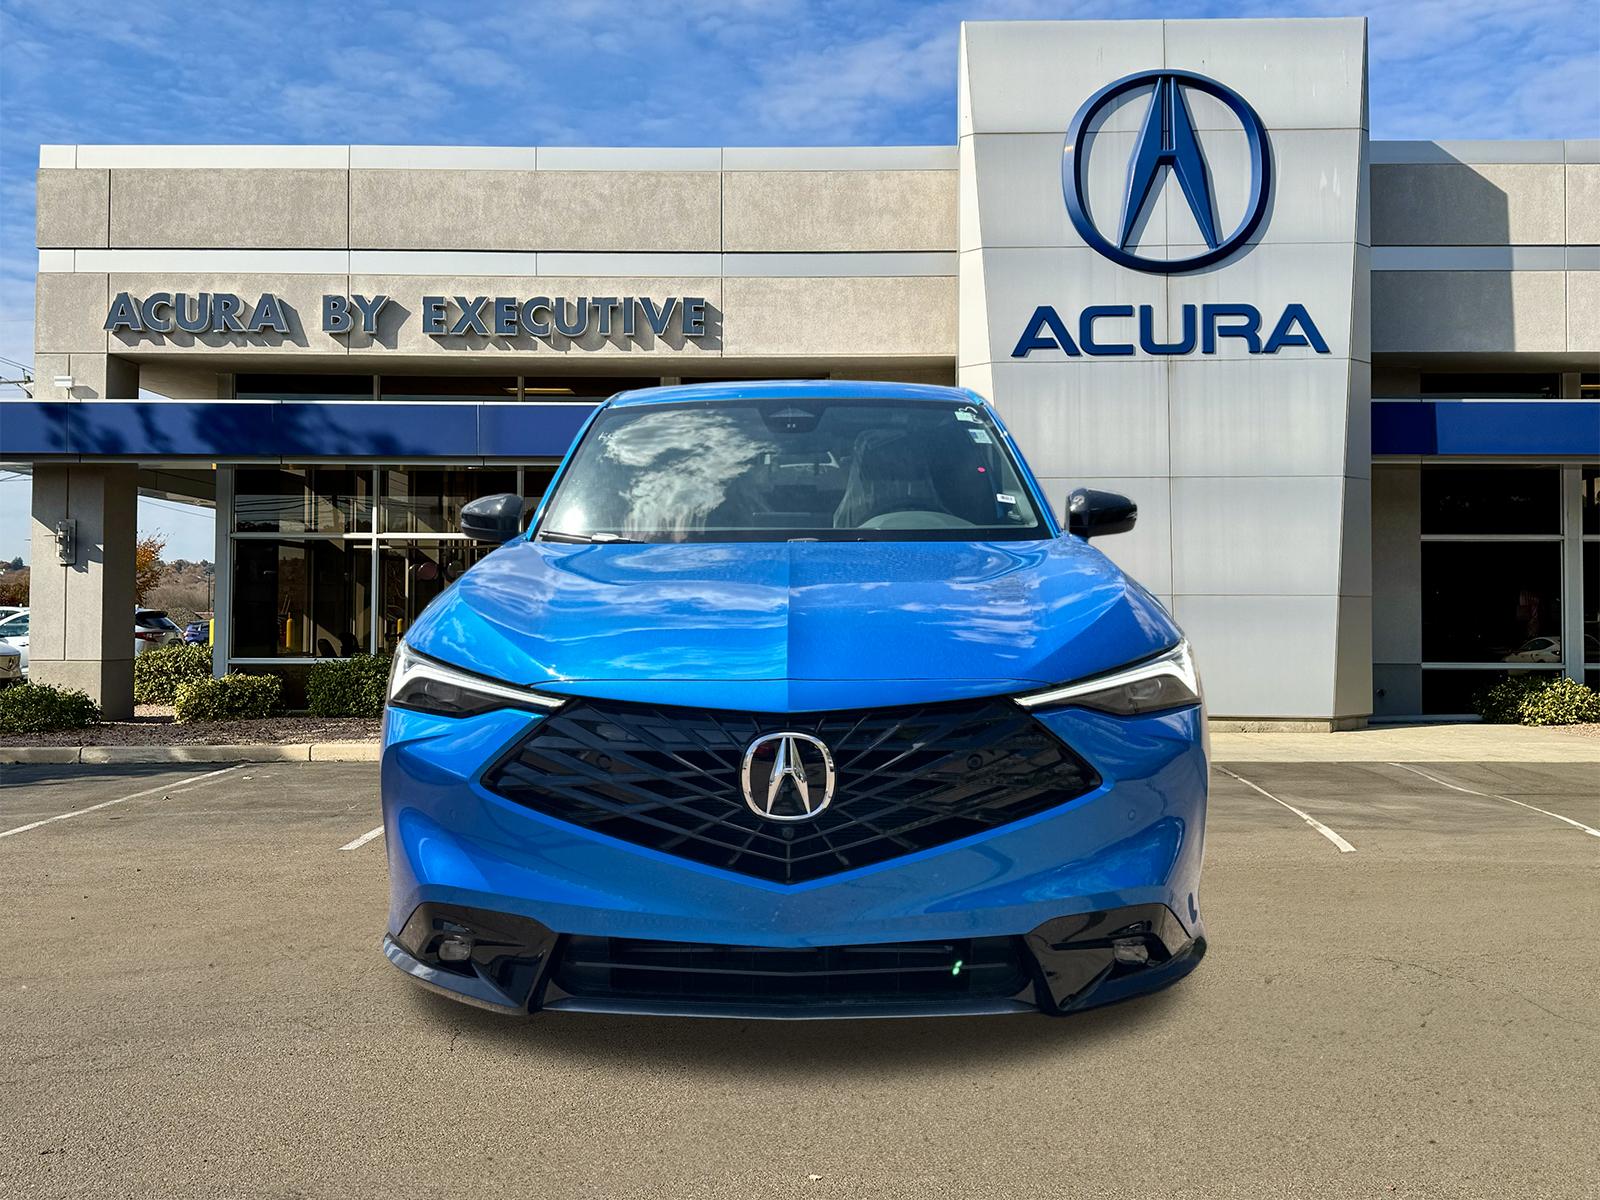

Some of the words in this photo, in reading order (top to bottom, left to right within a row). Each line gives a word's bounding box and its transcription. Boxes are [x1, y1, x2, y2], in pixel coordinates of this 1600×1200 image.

[104, 292, 290, 334] ACURA
[322, 294, 389, 334] BY
[422, 296, 706, 337] EXECUTIVE
[1011, 303, 1332, 357] ACURA
